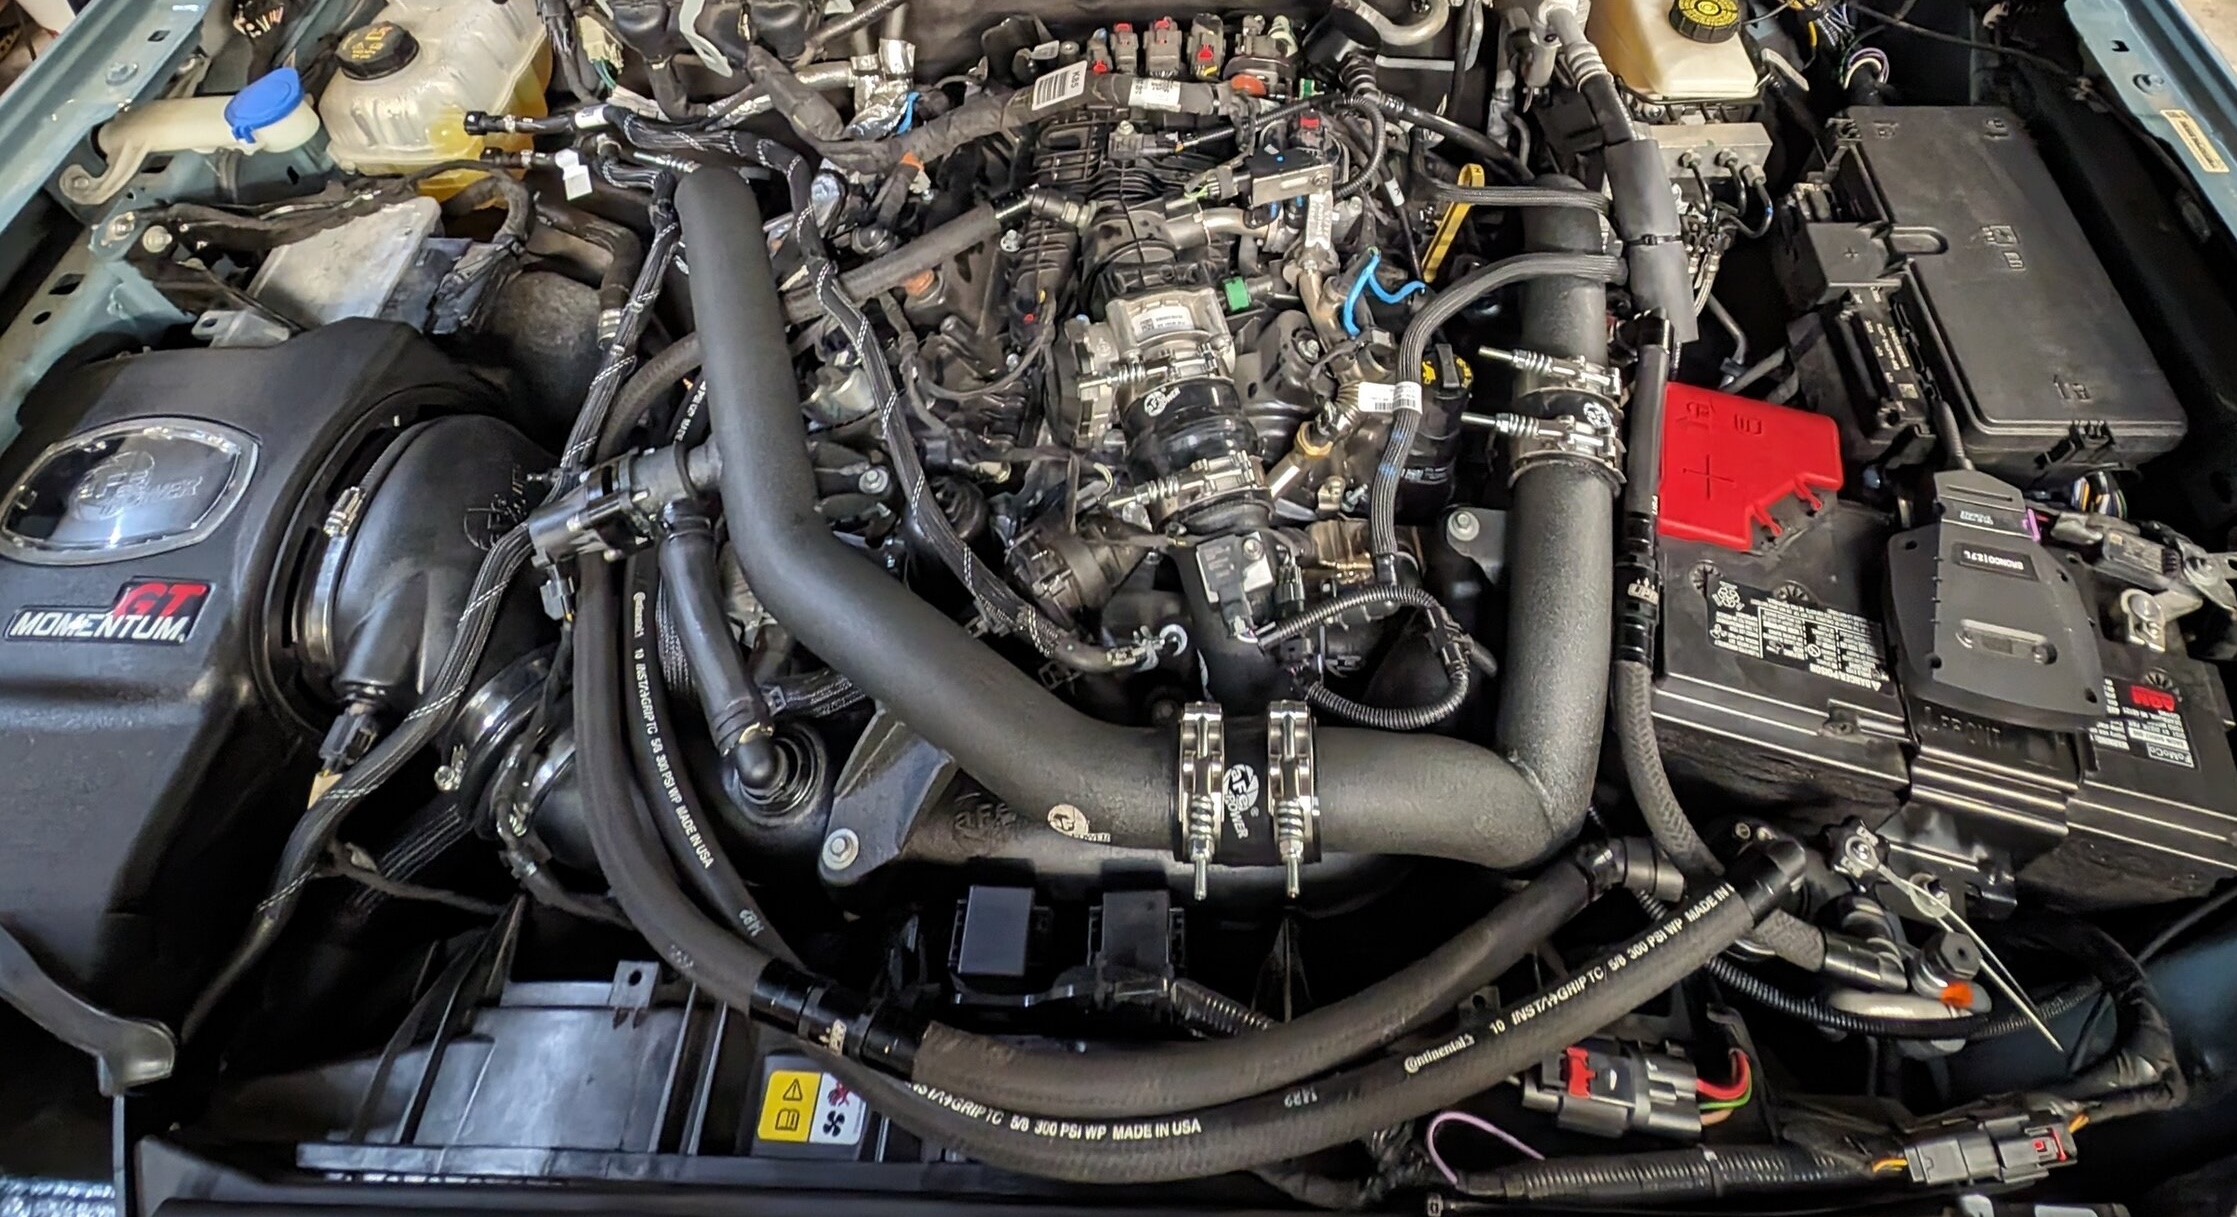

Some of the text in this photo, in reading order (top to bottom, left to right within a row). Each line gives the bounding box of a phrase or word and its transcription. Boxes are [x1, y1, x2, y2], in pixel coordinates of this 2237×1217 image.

[113, 581, 208, 618] GT
[9, 611, 190, 642] MOMENTUM
[2148, 744, 2191, 764] FoMoCo
[662, 771, 675, 789] PSI
[668, 787, 682, 804] WP
[675, 806, 696, 835] MADE
[690, 831, 701, 846] IN
[696, 844, 715, 870] USA
[1404, 1037, 1468, 1074] Continental
[1489, 1019, 1506, 1035] 10
[1587, 967, 1605, 984] TC
[1607, 953, 1628, 972] 5/8
[1627, 941, 1649, 961] 300
[1647, 929, 1668, 948] PSI
[1663, 917, 1684, 936] WP
[1683, 894, 1719, 923] MADE
[1714, 886, 1729, 903] IN
[985, 1106, 1003, 1125] TC
[1009, 1115, 1030, 1133] 5/8
[1034, 1121, 1058, 1137] 300
[1059, 1123, 1082, 1140] PSI
[1084, 1125, 1107, 1141] WP
[1111, 1123, 1153, 1141] MADE
[1154, 1121, 1170, 1138] IN
[1171, 1117, 1202, 1135] USA
